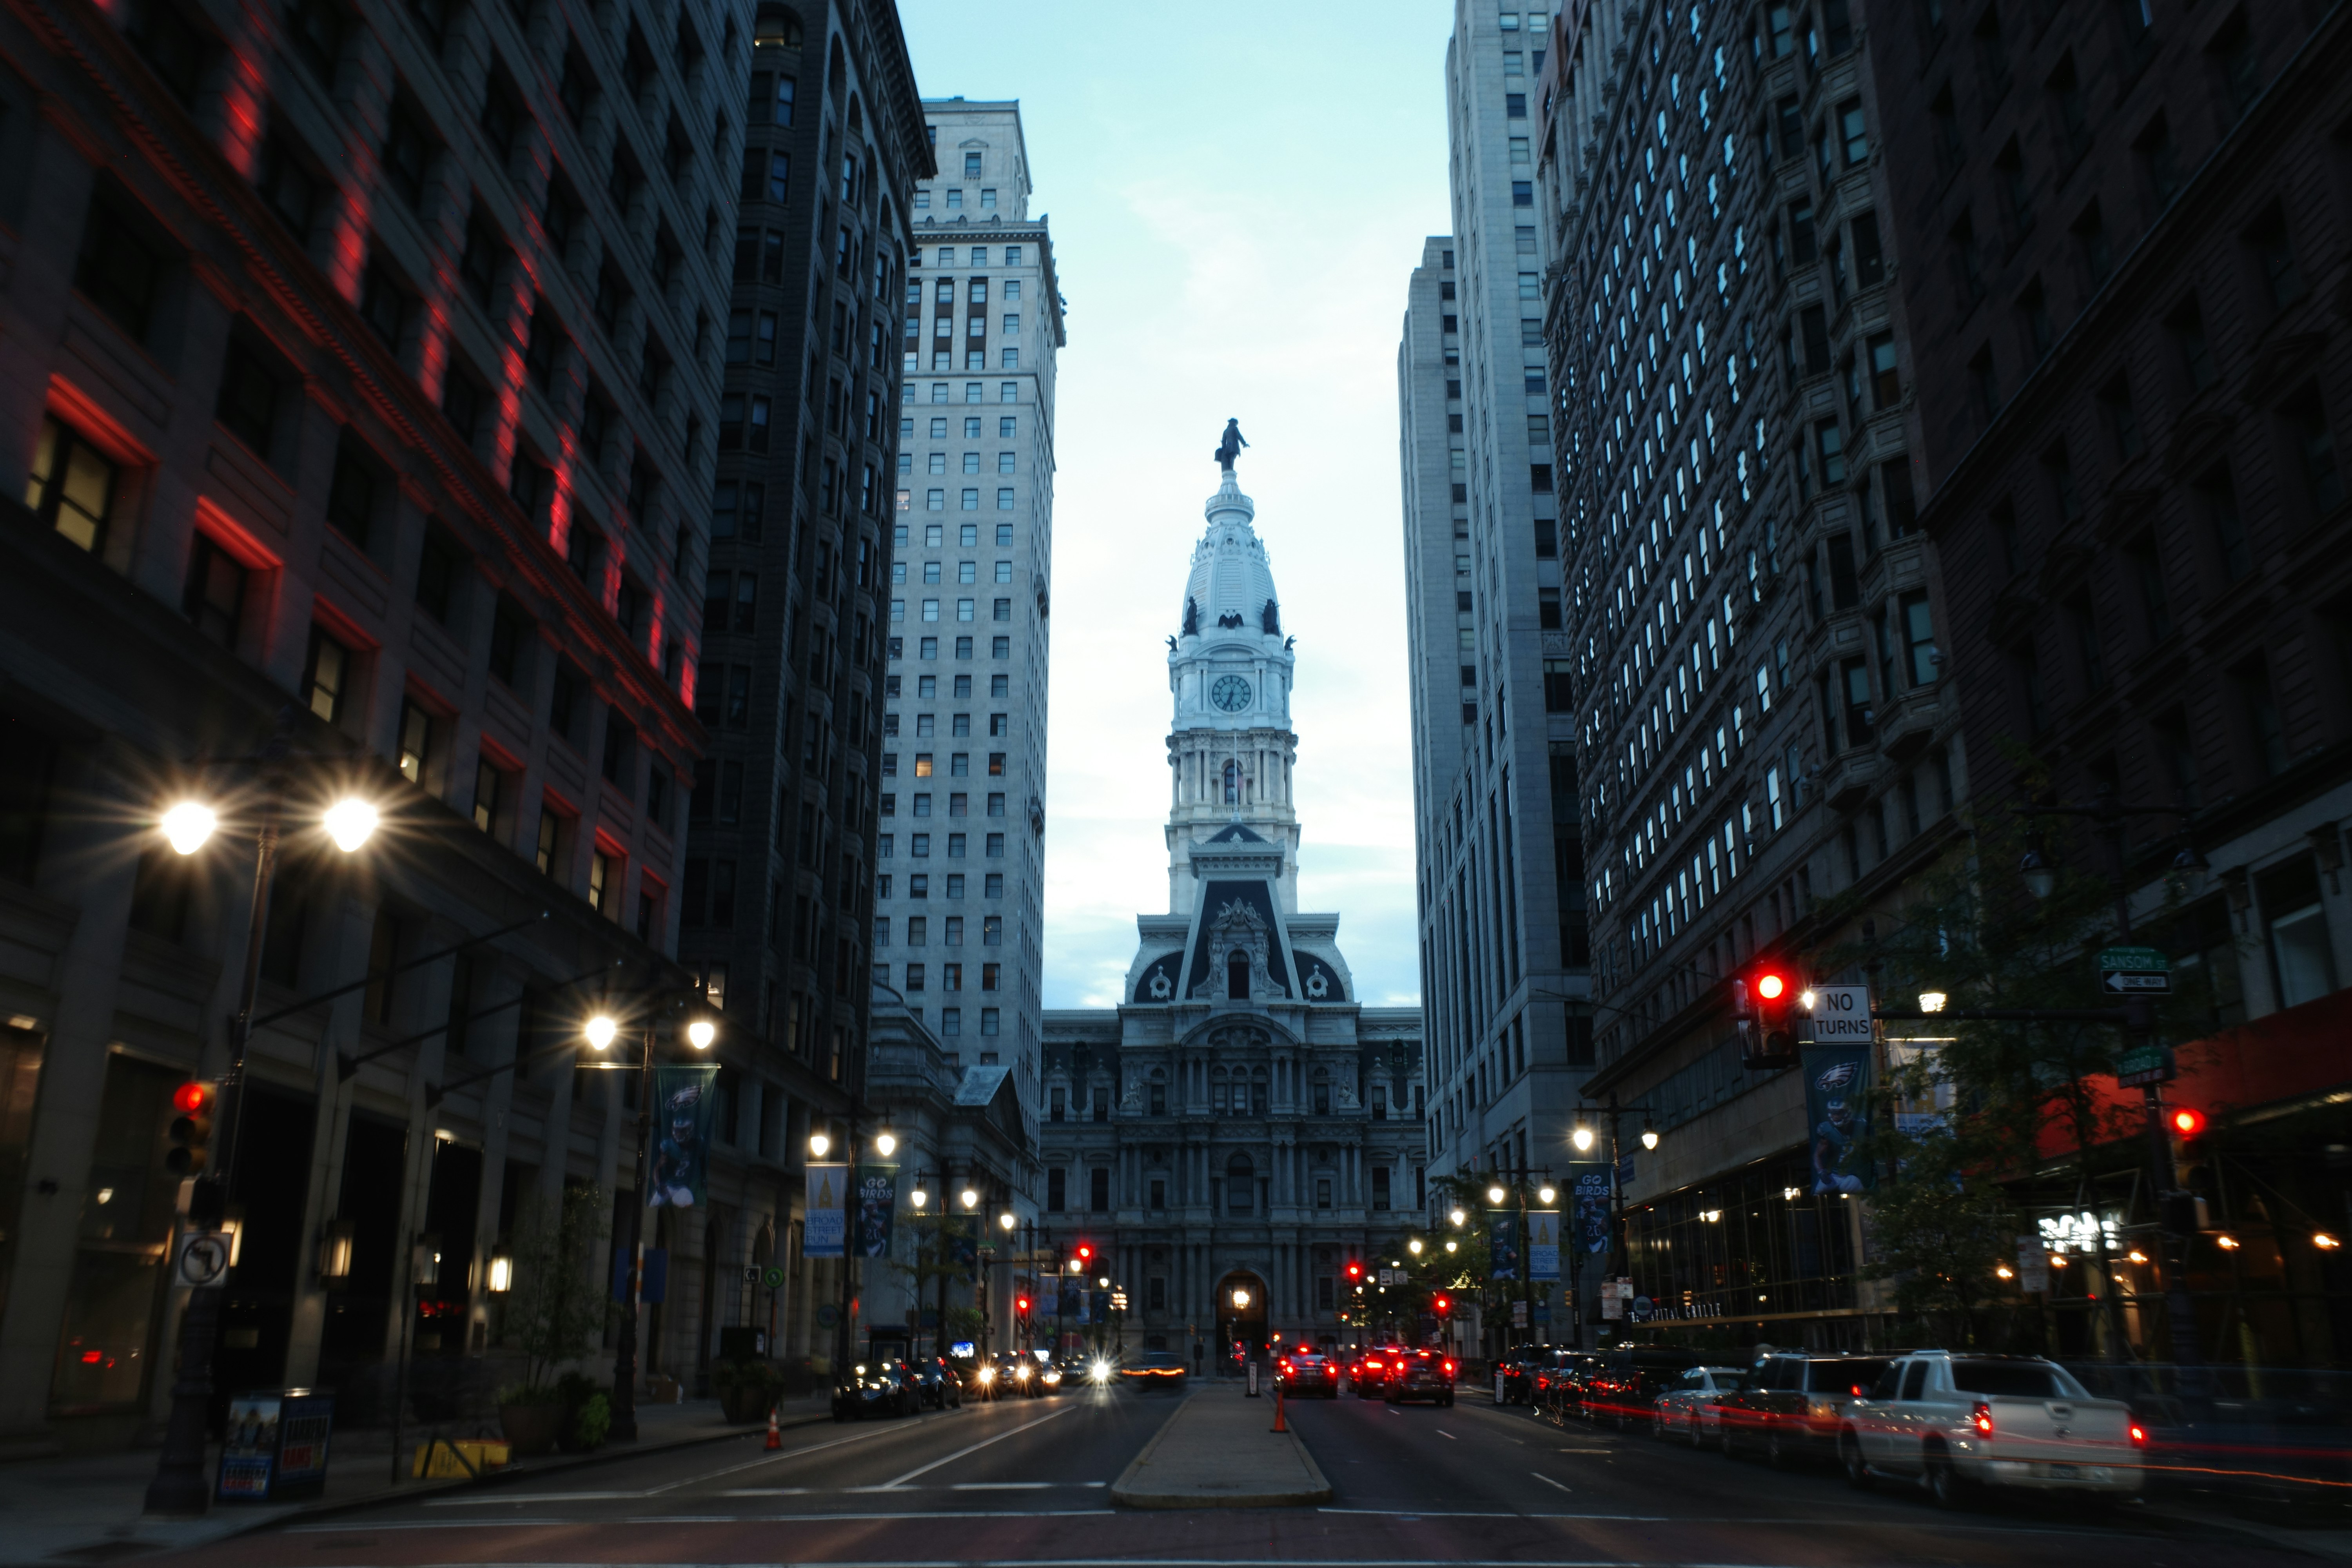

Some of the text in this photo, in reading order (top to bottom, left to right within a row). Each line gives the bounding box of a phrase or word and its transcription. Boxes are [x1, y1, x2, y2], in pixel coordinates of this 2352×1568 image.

[2101, 956, 2166, 969] SANSOM ST
[2123, 977, 2162, 986] ONE WAY
[1827, 993, 1853, 1011] NO
[1816, 1020, 1869, 1034] TURNS
[2124, 1055, 2151, 1074] BROAD
[867, 1177, 887, 1188] GO
[1582, 1175, 1602, 1185] GO
[860, 1188, 893, 1198] BIRDS
[1575, 1185, 1610, 1196] BIRDS
[866, 1228, 880, 1240] 26
[1586, 1225, 1601, 1236] 26
[1648, 1307, 1680, 1321] APITAL
[1684, 1303, 1721, 1318] GRILLE
